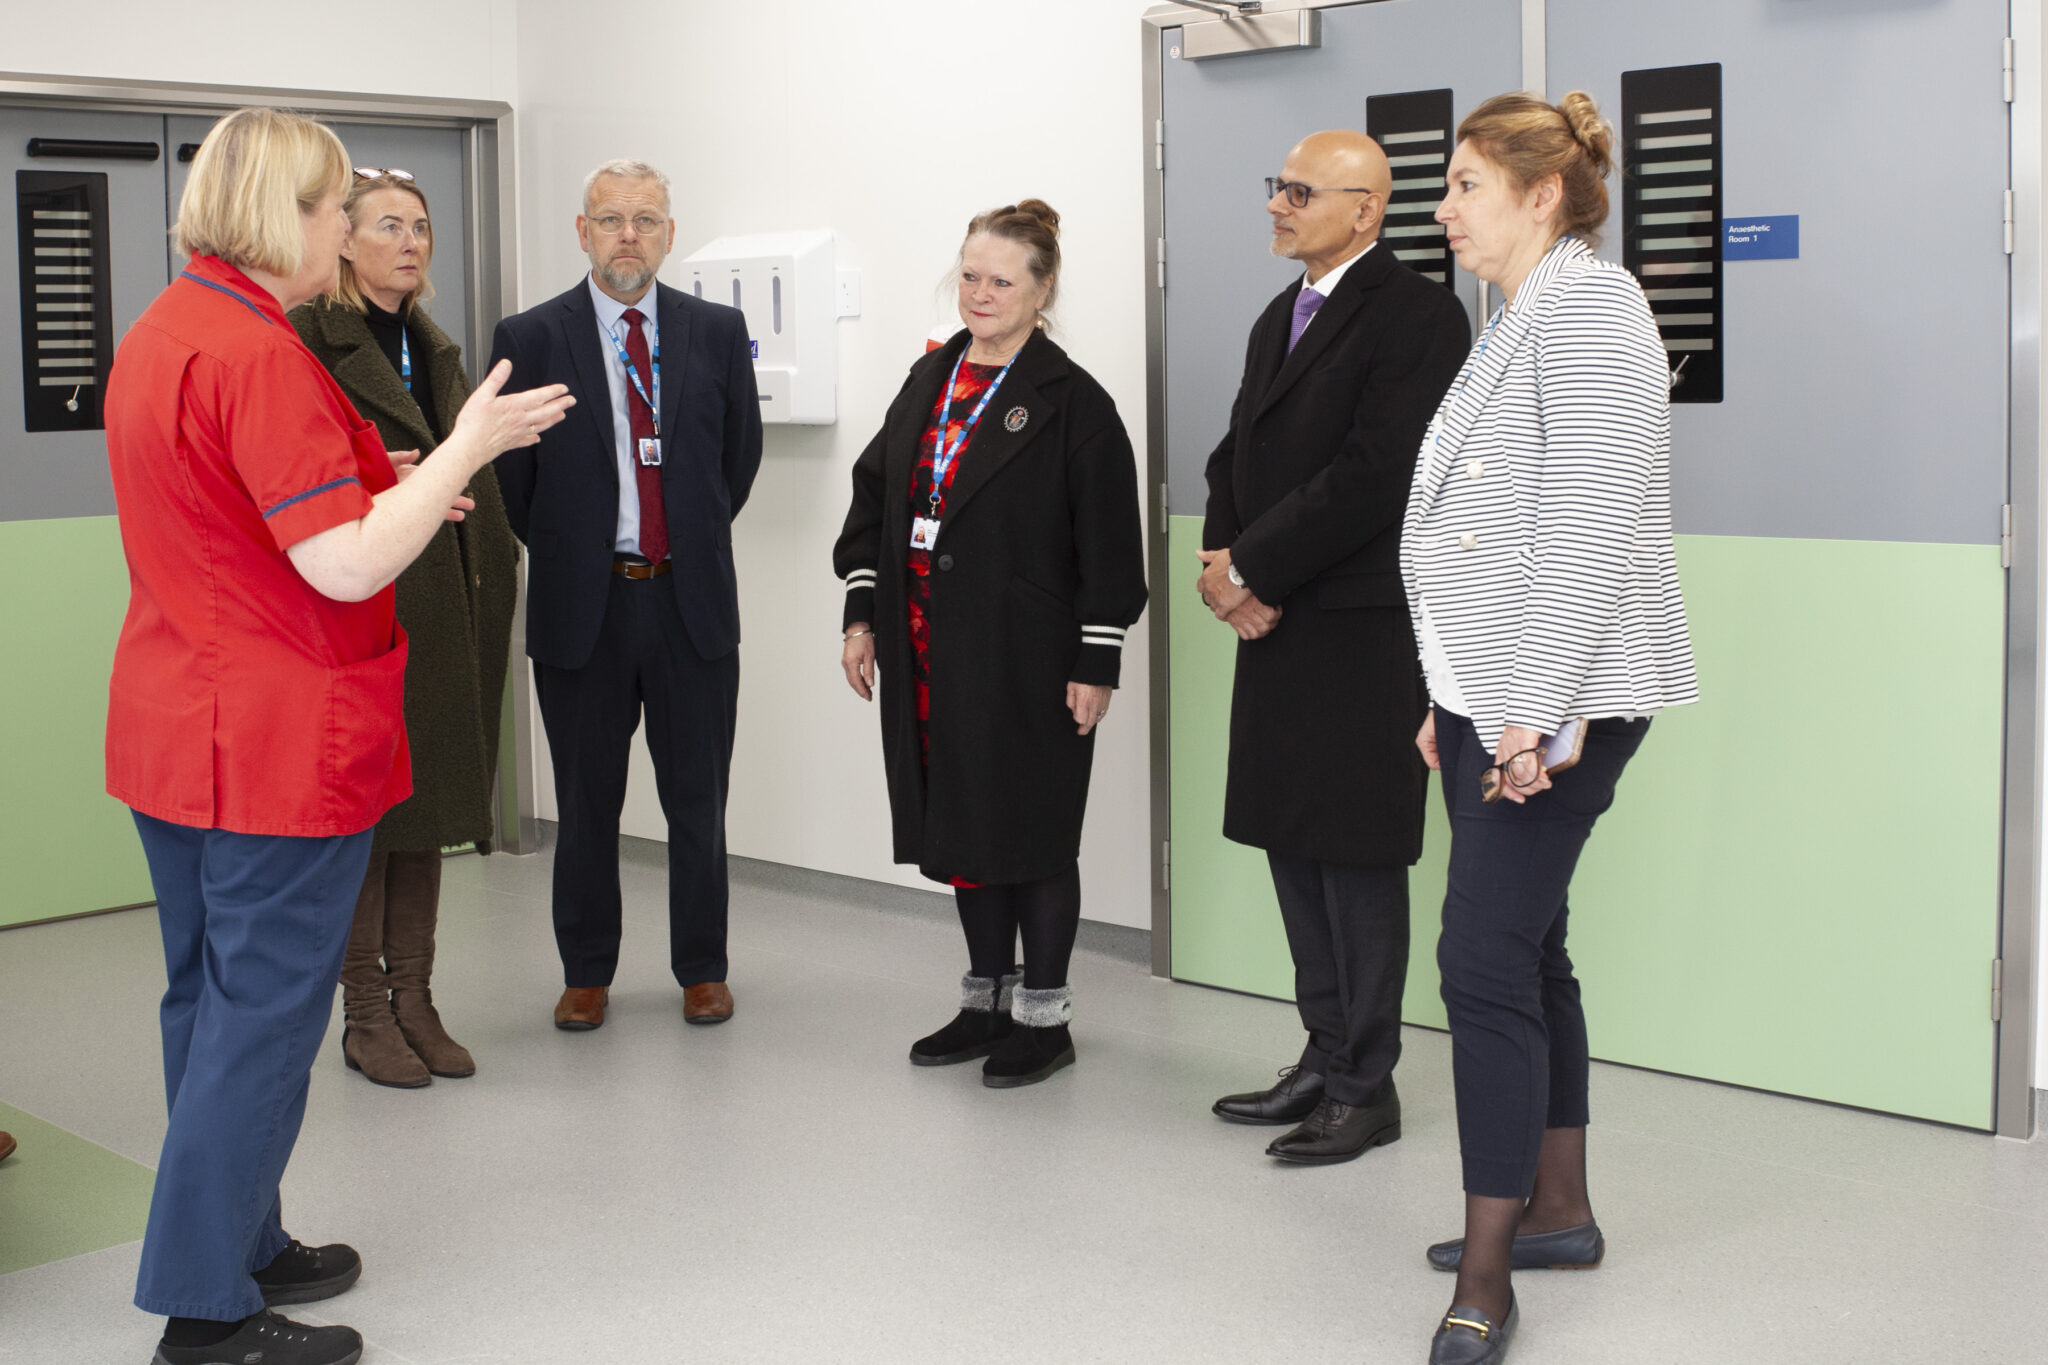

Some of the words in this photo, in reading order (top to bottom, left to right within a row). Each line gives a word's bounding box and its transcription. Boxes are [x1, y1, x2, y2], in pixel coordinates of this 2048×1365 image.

[1729, 224, 1771, 233] Anaesthetic
[1753, 234, 1758, 242] 1
[631, 373, 642, 387] NHS
[995, 370, 1007, 385] NHS
[983, 386, 996, 401] NHS
[972, 402, 985, 417] NHS
[935, 440, 944, 454] NHS
[947, 441, 960, 456] NHS
[934, 458, 942, 473] NHS
[939, 458, 950, 474] NHS
